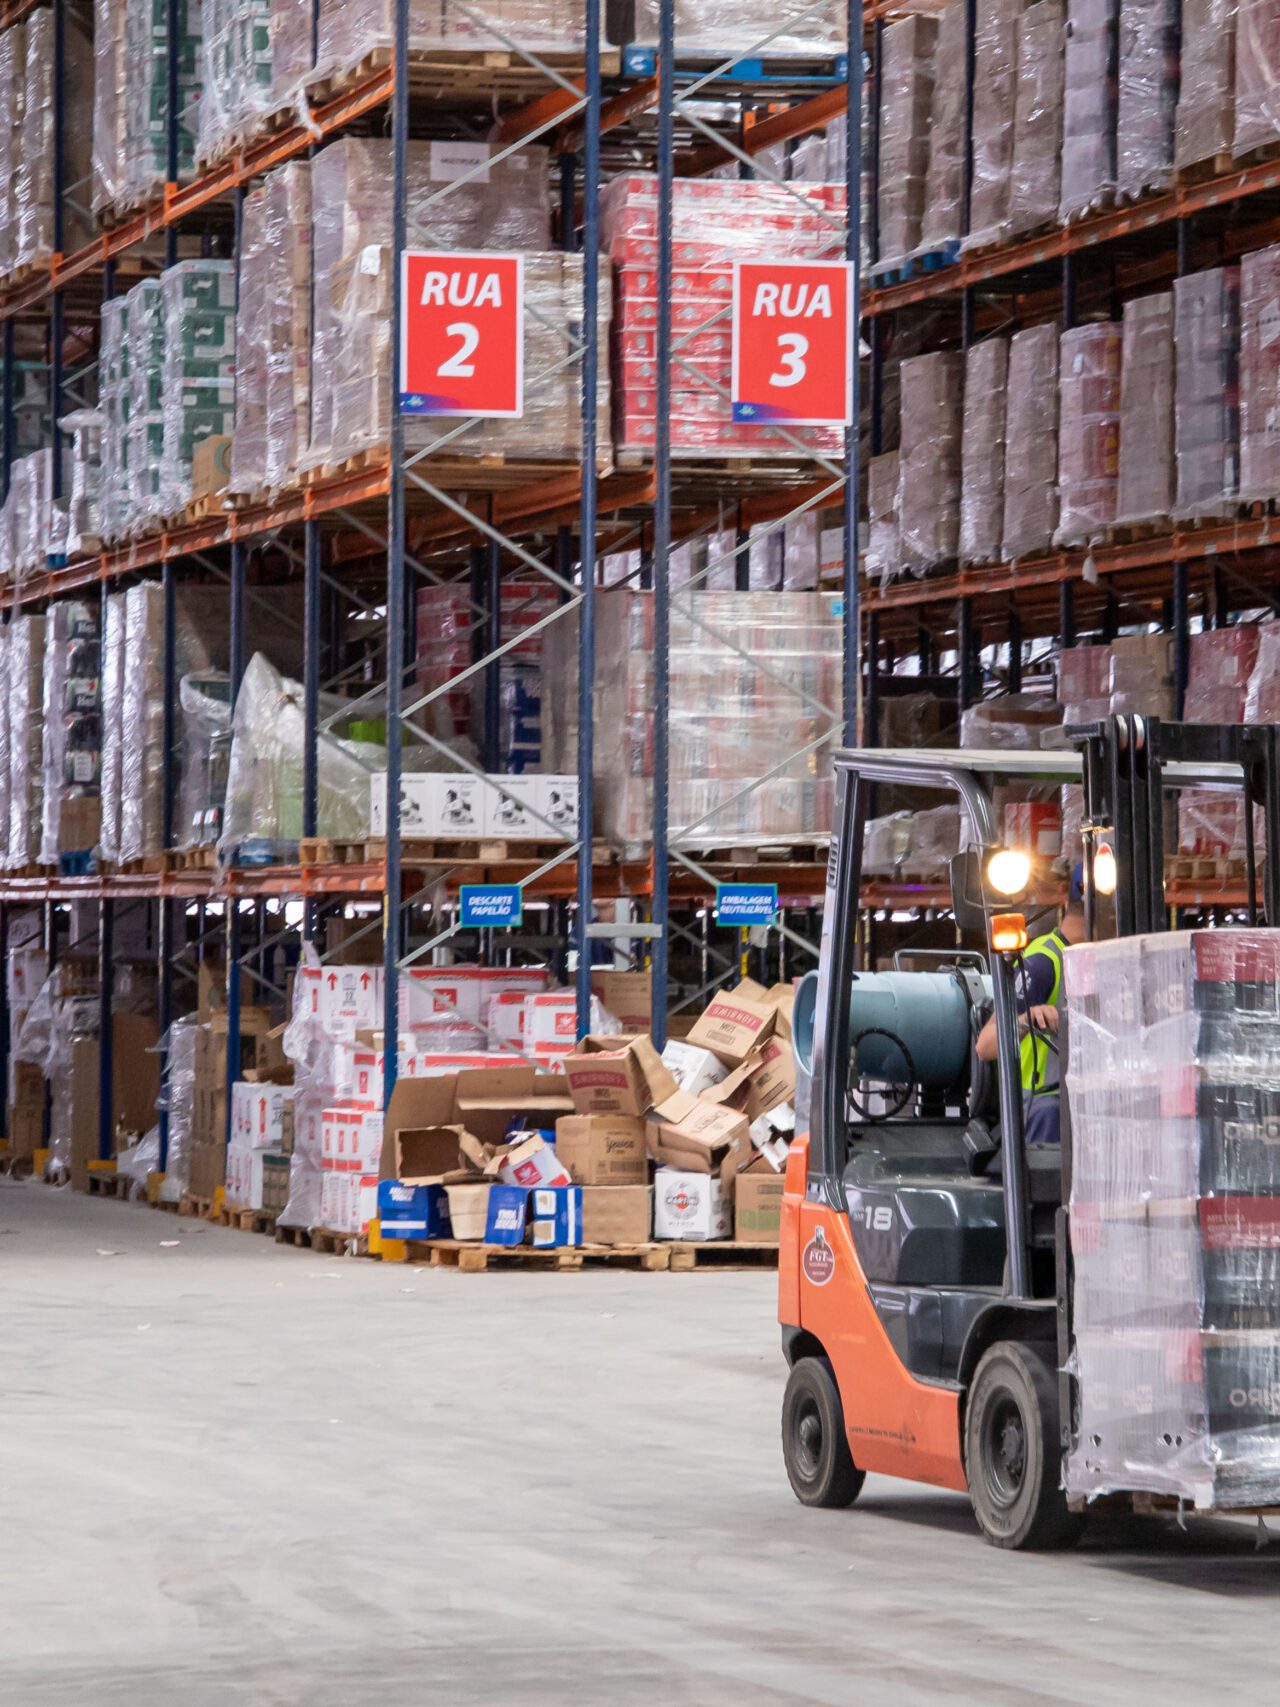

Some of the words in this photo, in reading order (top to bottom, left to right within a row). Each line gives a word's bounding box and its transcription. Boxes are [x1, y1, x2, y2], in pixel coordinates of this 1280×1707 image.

[421, 272, 501, 307] RUA
[753, 283, 831, 317] RUA
[437, 323, 479, 377] 2
[769, 333, 808, 386] 3
[468, 896, 513, 905] DESCARTE
[471, 904, 511, 915] PAPELÃO
[721, 896, 773, 904] EMBALAGEM
[865, 1206, 893, 1231] 18
